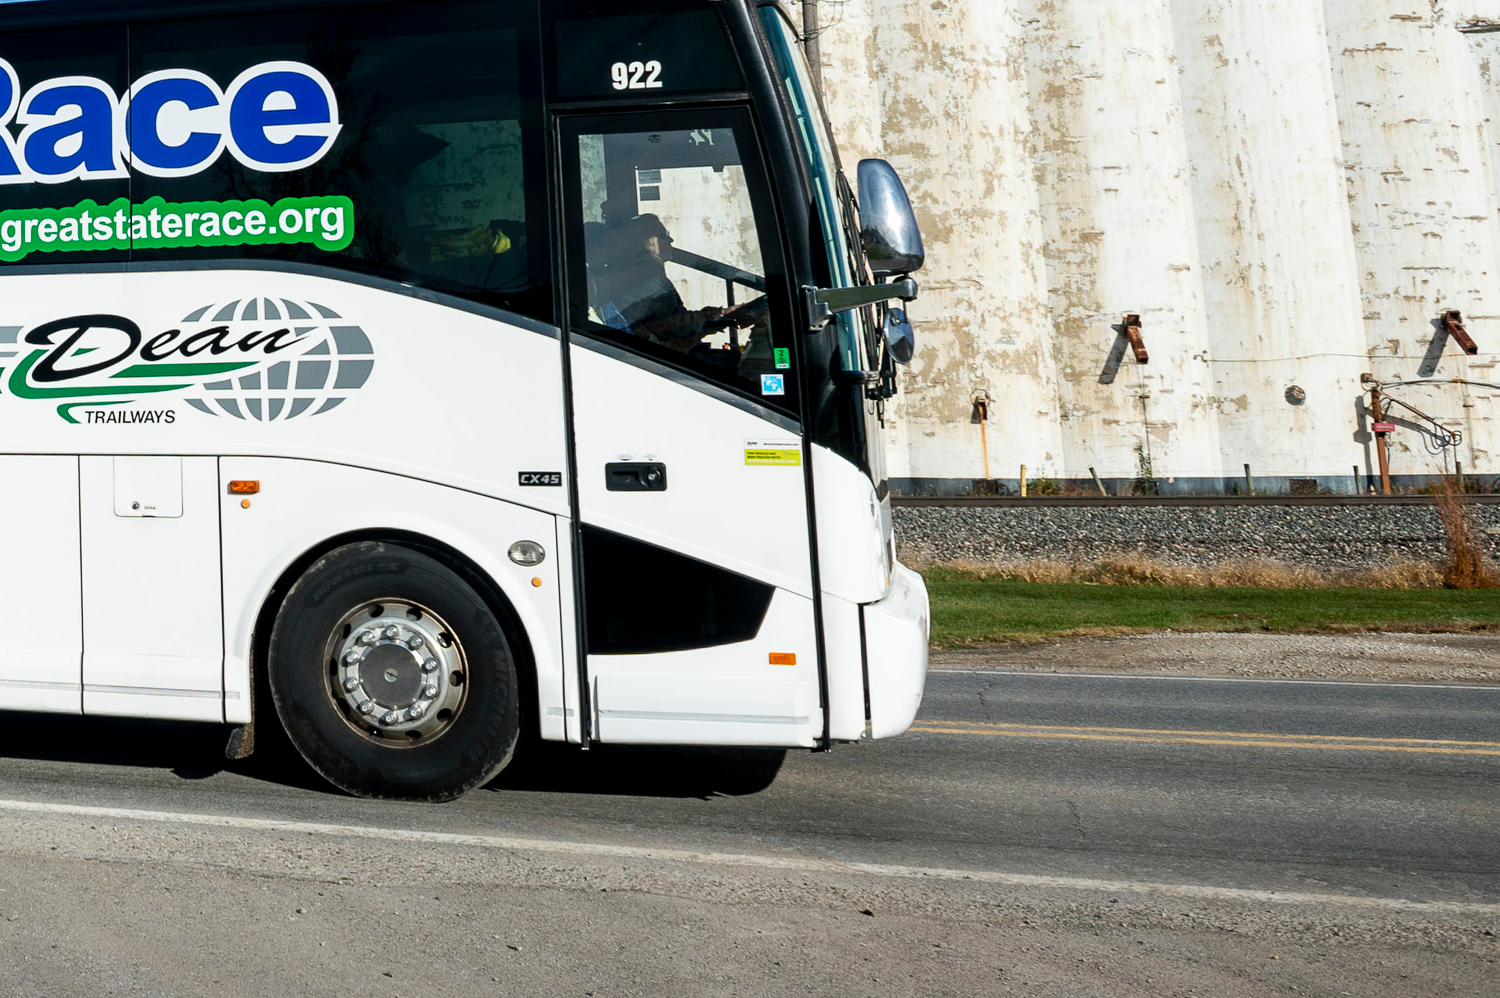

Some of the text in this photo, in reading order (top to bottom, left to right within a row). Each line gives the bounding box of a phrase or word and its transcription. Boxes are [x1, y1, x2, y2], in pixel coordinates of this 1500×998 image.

[612, 61, 663, 90] 922
[25, 314, 308, 383] Dean
[85, 410, 176, 424] TRAILWAYS
[520, 474, 560, 484] CX45
